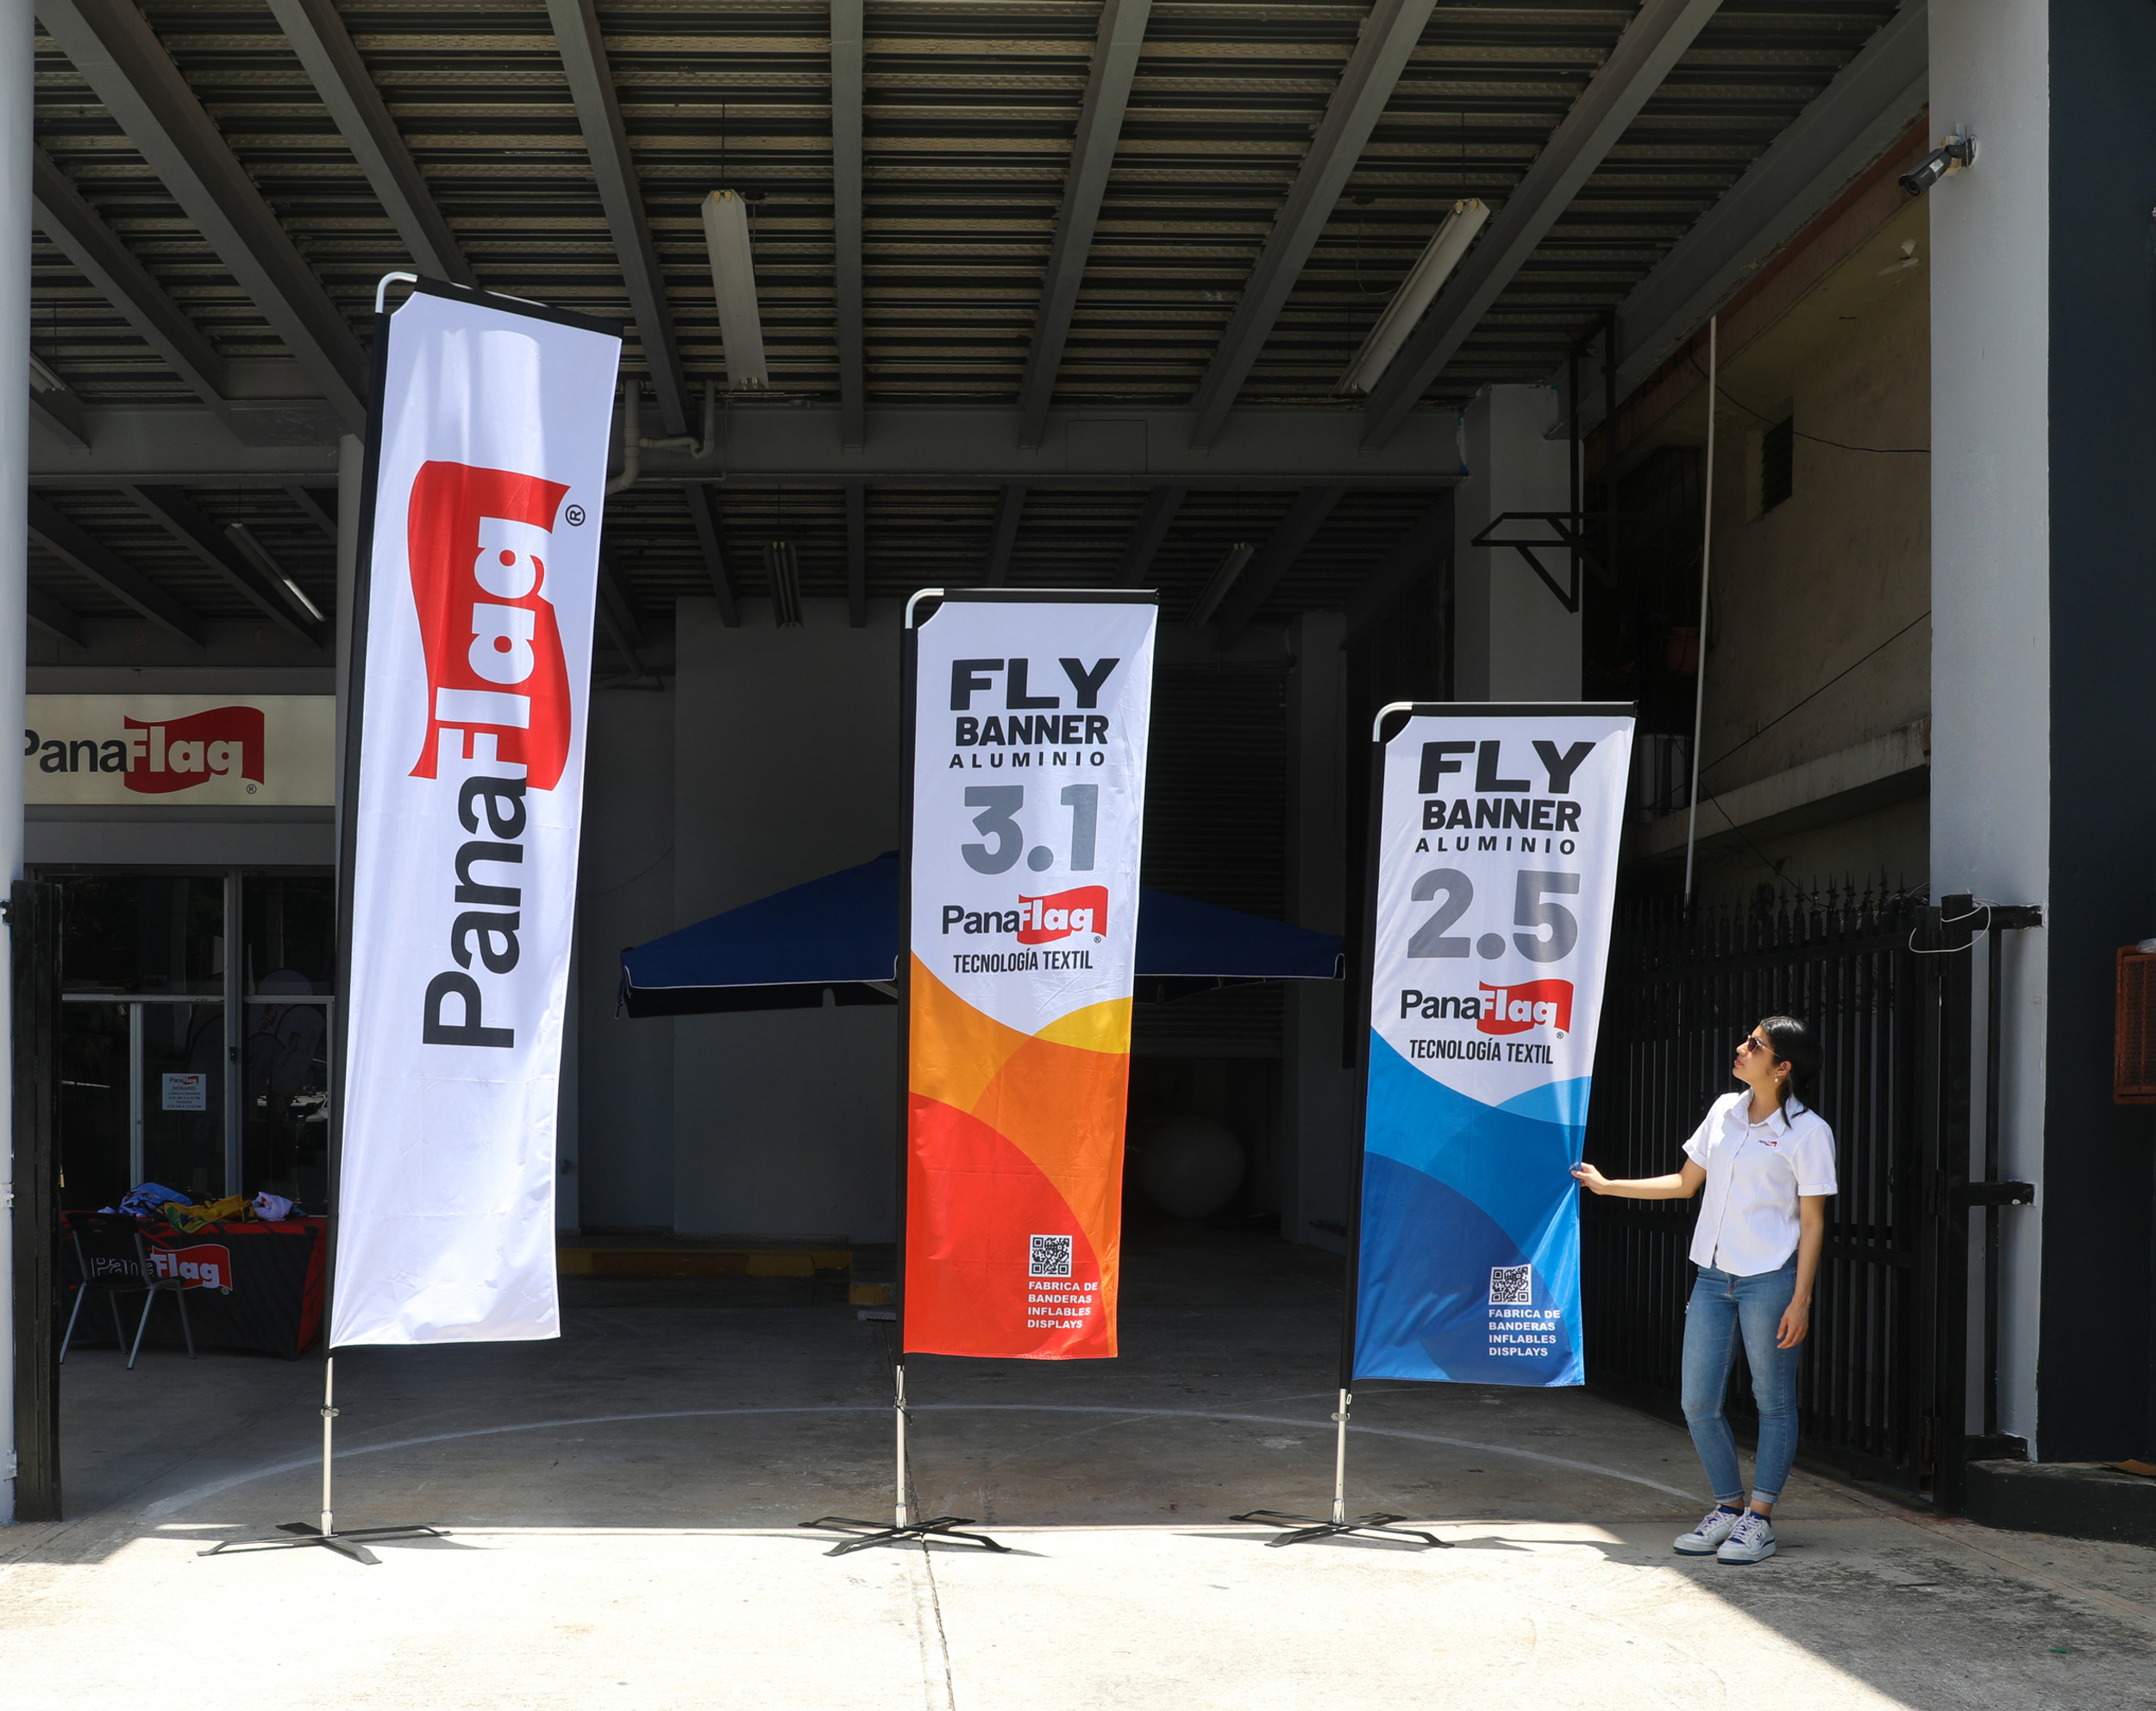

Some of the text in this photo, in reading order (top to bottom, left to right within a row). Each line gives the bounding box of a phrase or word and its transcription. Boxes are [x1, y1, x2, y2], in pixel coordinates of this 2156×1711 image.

[950, 657, 1120, 711] FLY
[955, 714, 1110, 746] BANNER
[949, 750, 1106, 768] ALUMINIO
[1418, 739, 1596, 794] FLY
[423, 515, 552, 1048] PanaFlag
[1421, 798, 1582, 832] BANNER
[961, 783, 1099, 875] 3.1
[1414, 835, 1576, 855] ALUMINIO
[942, 899, 1094, 936] PanaFlag
[1407, 867, 1581, 963] 2.5
[953, 948, 1094, 974] TECNOLOGÍA TEXTIL
[1400, 987, 1557, 1027] PanaFlag
[1409, 1037, 1554, 1065] TECNOLOGÍA TEXTIL
[1028, 1281, 1099, 1291] FABRICA DE
[1028, 1294, 1093, 1304] BANDERAS
[1027, 1307, 1091, 1317] INFLABLES
[1027, 1319, 1083, 1329] DISPLAYS
[1489, 1309, 1561, 1319] FABRICA DE
[1489, 1321, 1556, 1332] BANDERAS
[1489, 1334, 1557, 1344] INFLABLES
[1489, 1347, 1548, 1357] DISPLAYS
